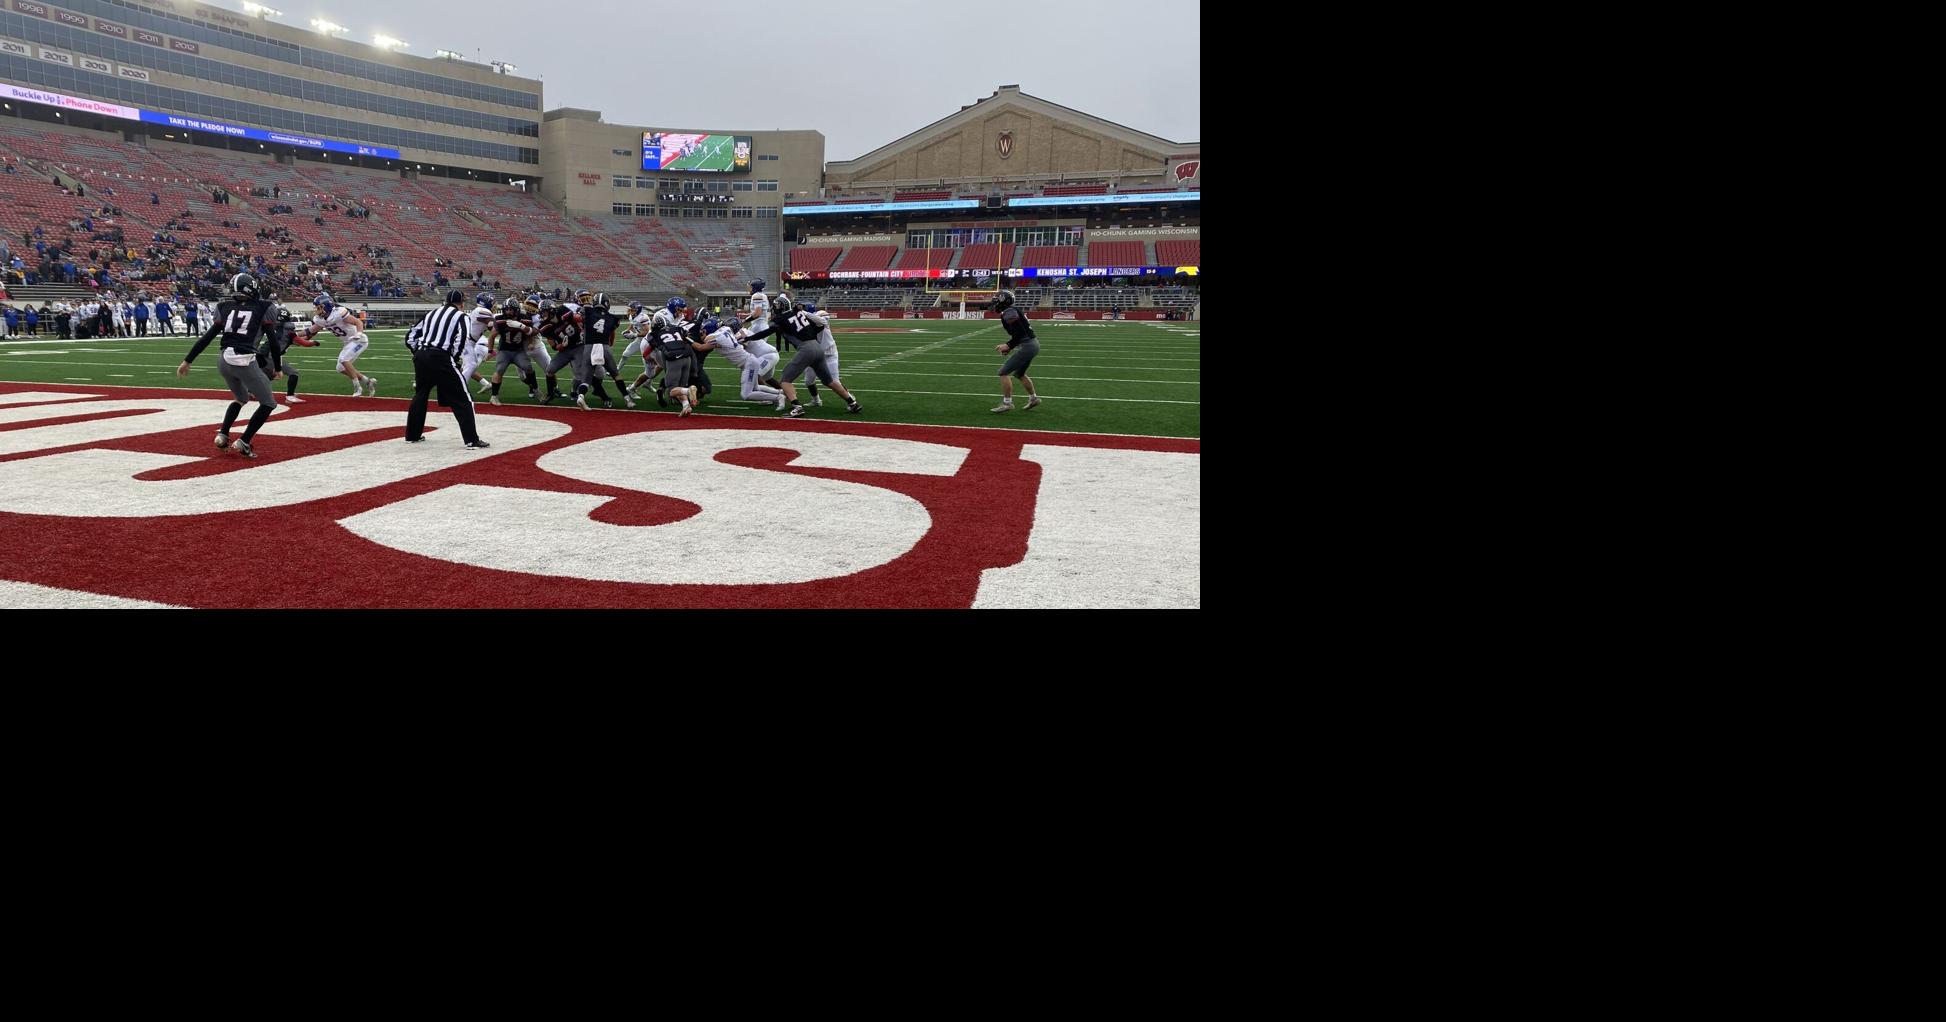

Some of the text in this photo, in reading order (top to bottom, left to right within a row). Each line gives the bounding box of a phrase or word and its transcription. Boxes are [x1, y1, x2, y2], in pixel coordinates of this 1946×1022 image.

[18, 2, 43, 14] 1998
[60, 13, 85, 24] 1999
[100, 23, 124, 34] 2010
[139, 32, 159, 43] 2011
[2, 42, 25, 54] 2011
[175, 41, 195, 51] 2012
[44, 51, 68, 63] 2012
[85, 60, 107, 71] 2013
[122, 68, 146, 79] 2020
[12, 88, 118, 114] Buckle Up Phone Down
[169, 116, 246, 135] TAKE THE PLEDGE NOW!
[890, 270, 904, 278] CITY
[1037, 268, 1067, 276] KENOSHA
[1068, 268, 1079, 276] ST.
[1081, 268, 1107, 276] JOSEPH
[224, 309, 253, 335] 17
[593, 319, 606, 334] 4
[788, 310, 810, 332] 72
[660, 332, 683, 343] 21
